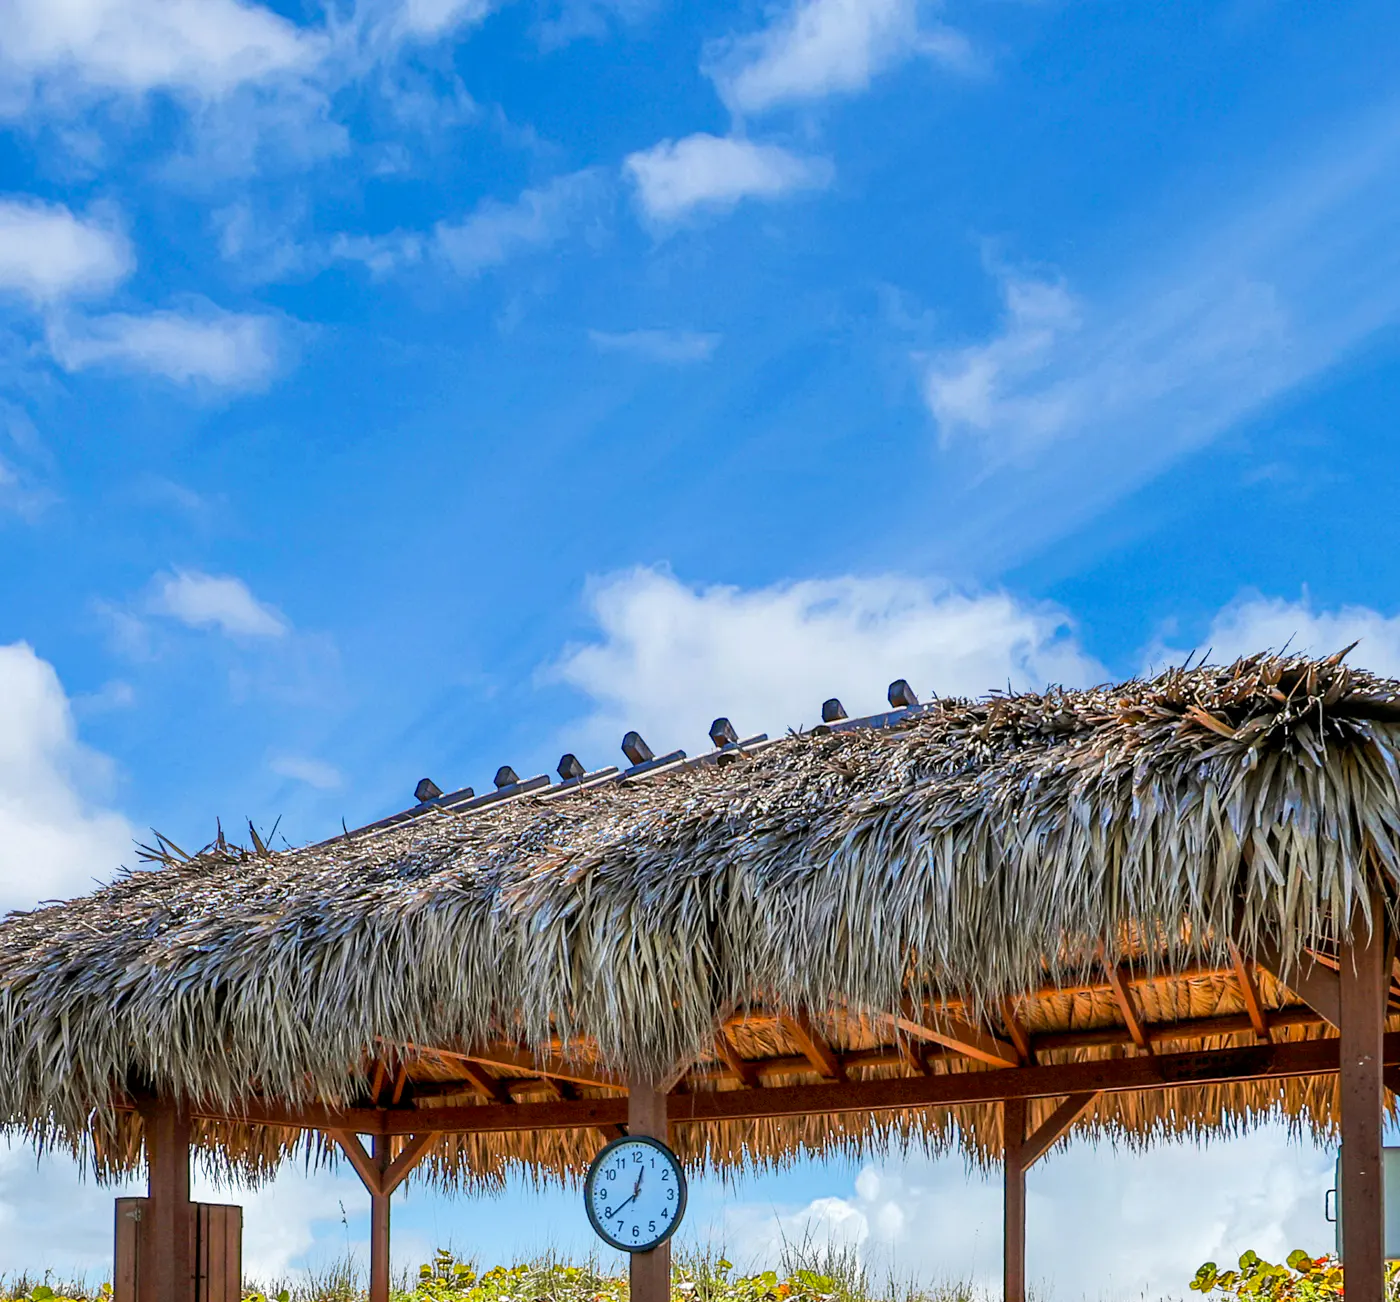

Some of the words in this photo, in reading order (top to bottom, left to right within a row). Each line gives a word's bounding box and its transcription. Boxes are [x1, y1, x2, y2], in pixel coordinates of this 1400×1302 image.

[632, 1151, 643, 1163] 12
[650, 1157, 655, 1169] 1
[615, 1158, 626, 1169] 11
[605, 1169, 616, 1181] 10
[661, 1169, 669, 1181] 2
[600, 1188, 607, 1200] 9
[666, 1188, 674, 1200] 3
[604, 1206, 612, 1219] 8
[661, 1208, 668, 1219] 4
[617, 1221, 624, 1232] 7
[632, 1226, 640, 1237] 6
[648, 1221, 656, 1232] 5
